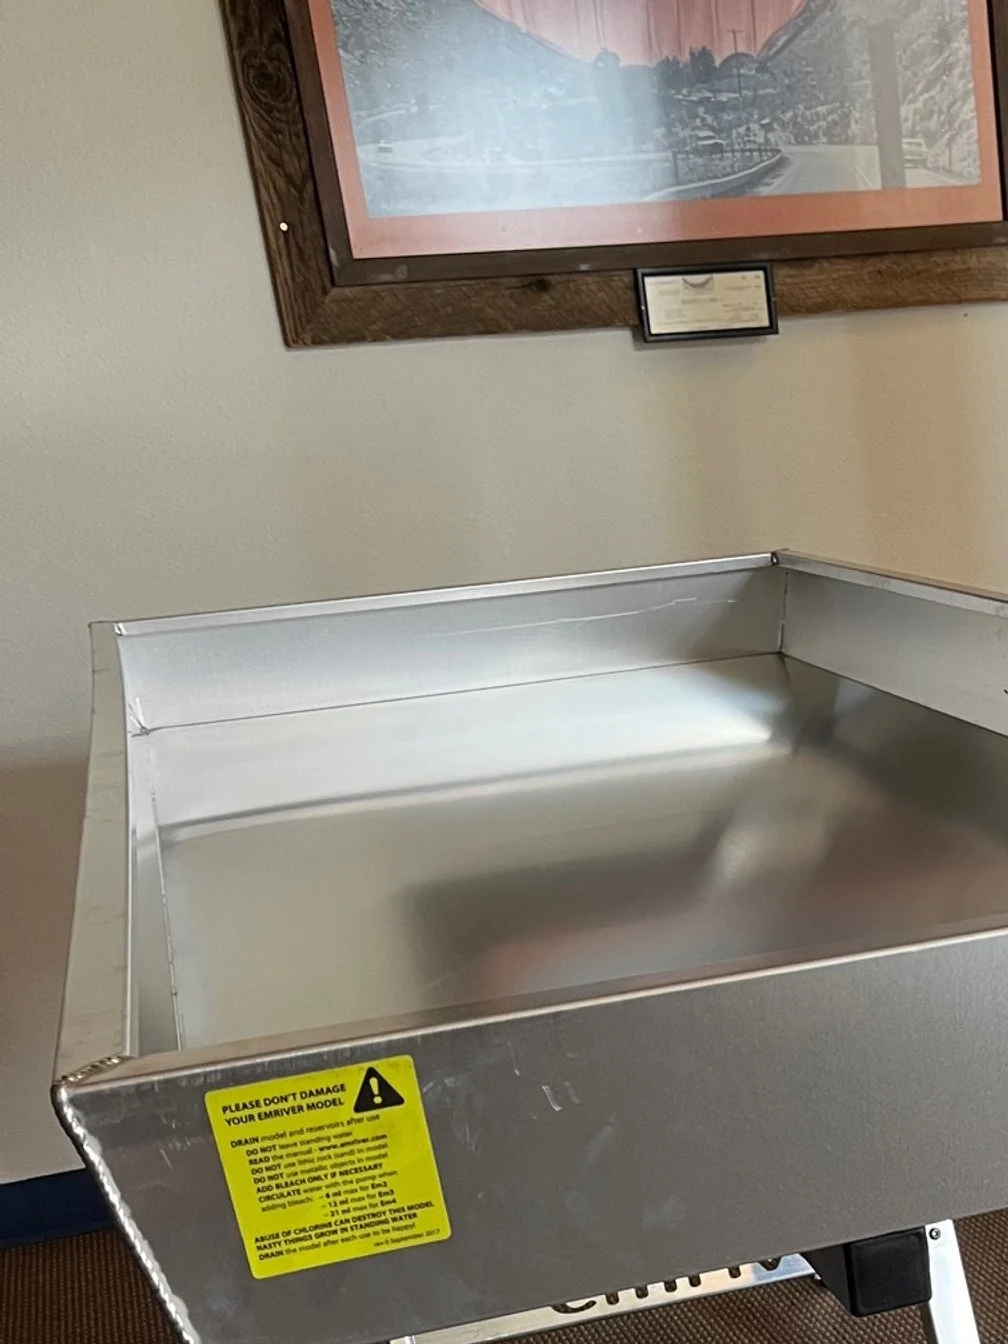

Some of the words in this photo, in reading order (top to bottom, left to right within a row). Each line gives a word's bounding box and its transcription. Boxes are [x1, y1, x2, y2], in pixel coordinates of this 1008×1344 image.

[222, 1099, 262, 1114] PLEASE
[263, 1092, 297, 1107] DON'T
[299, 1083, 346, 1100] DAMAGE
[225, 1114, 256, 1126] YOUR
[257, 1104, 304, 1121] EMRIVER
[306, 1098, 344, 1111] MODEL
[230, 1136, 259, 1148] DRAIN
[260, 1131, 287, 1142] model
[289, 1128, 305, 1137] and
[306, 1121, 345, 1133] reservoirs
[346, 1117, 364, 1126] after
[366, 1114, 380, 1122] use
[246, 1148, 259, 1157] DO
[259, 1144, 276, 1154] NOT
[278, 1142, 298, 1150] leave
[299, 1135, 331, 1146] standing
[332, 1131, 352, 1139] water
[248, 1156, 270, 1166] READ
[271, 1154, 284, 1162] the
[285, 1147, 313, 1159] manual
[318, 1134, 387, 1152] www.emriver.com
[251, 1167, 263, 1175] DO
[265, 1163, 281, 1172] NOT
[253, 1176, 266, 1185] DO
[267, 1172, 284, 1182] NOT
[256, 1184, 274, 1194] ADD
[275, 1178, 306, 1190] BLEACH
[307, 1173, 328, 1183] ONLY
[330, 1171, 337, 1179] IF
[339, 1163, 382, 1177] NECESSARY
[258, 1188, 301, 1203] CIRCULATE
[255, 1232, 280, 1244] ABUSE
[281, 1230, 292, 1238] OF
[293, 1221, 333, 1235] CHLORINE
[334, 1218, 351, 1226] CAN
[351, 1210, 386, 1223] DESTROY
[388, 1207, 406, 1215] THIS
[407, 1201, 434, 1211] MODEL
[256, 1240, 282, 1251] NASTY
[283, 1234, 313, 1246] THINGS
[314, 1229, 338, 1239] GROW
[349, 1218, 390, 1232] STANDING
[390, 1212, 418, 1223] WATER
[259, 1250, 284, 1261] DRAIN
